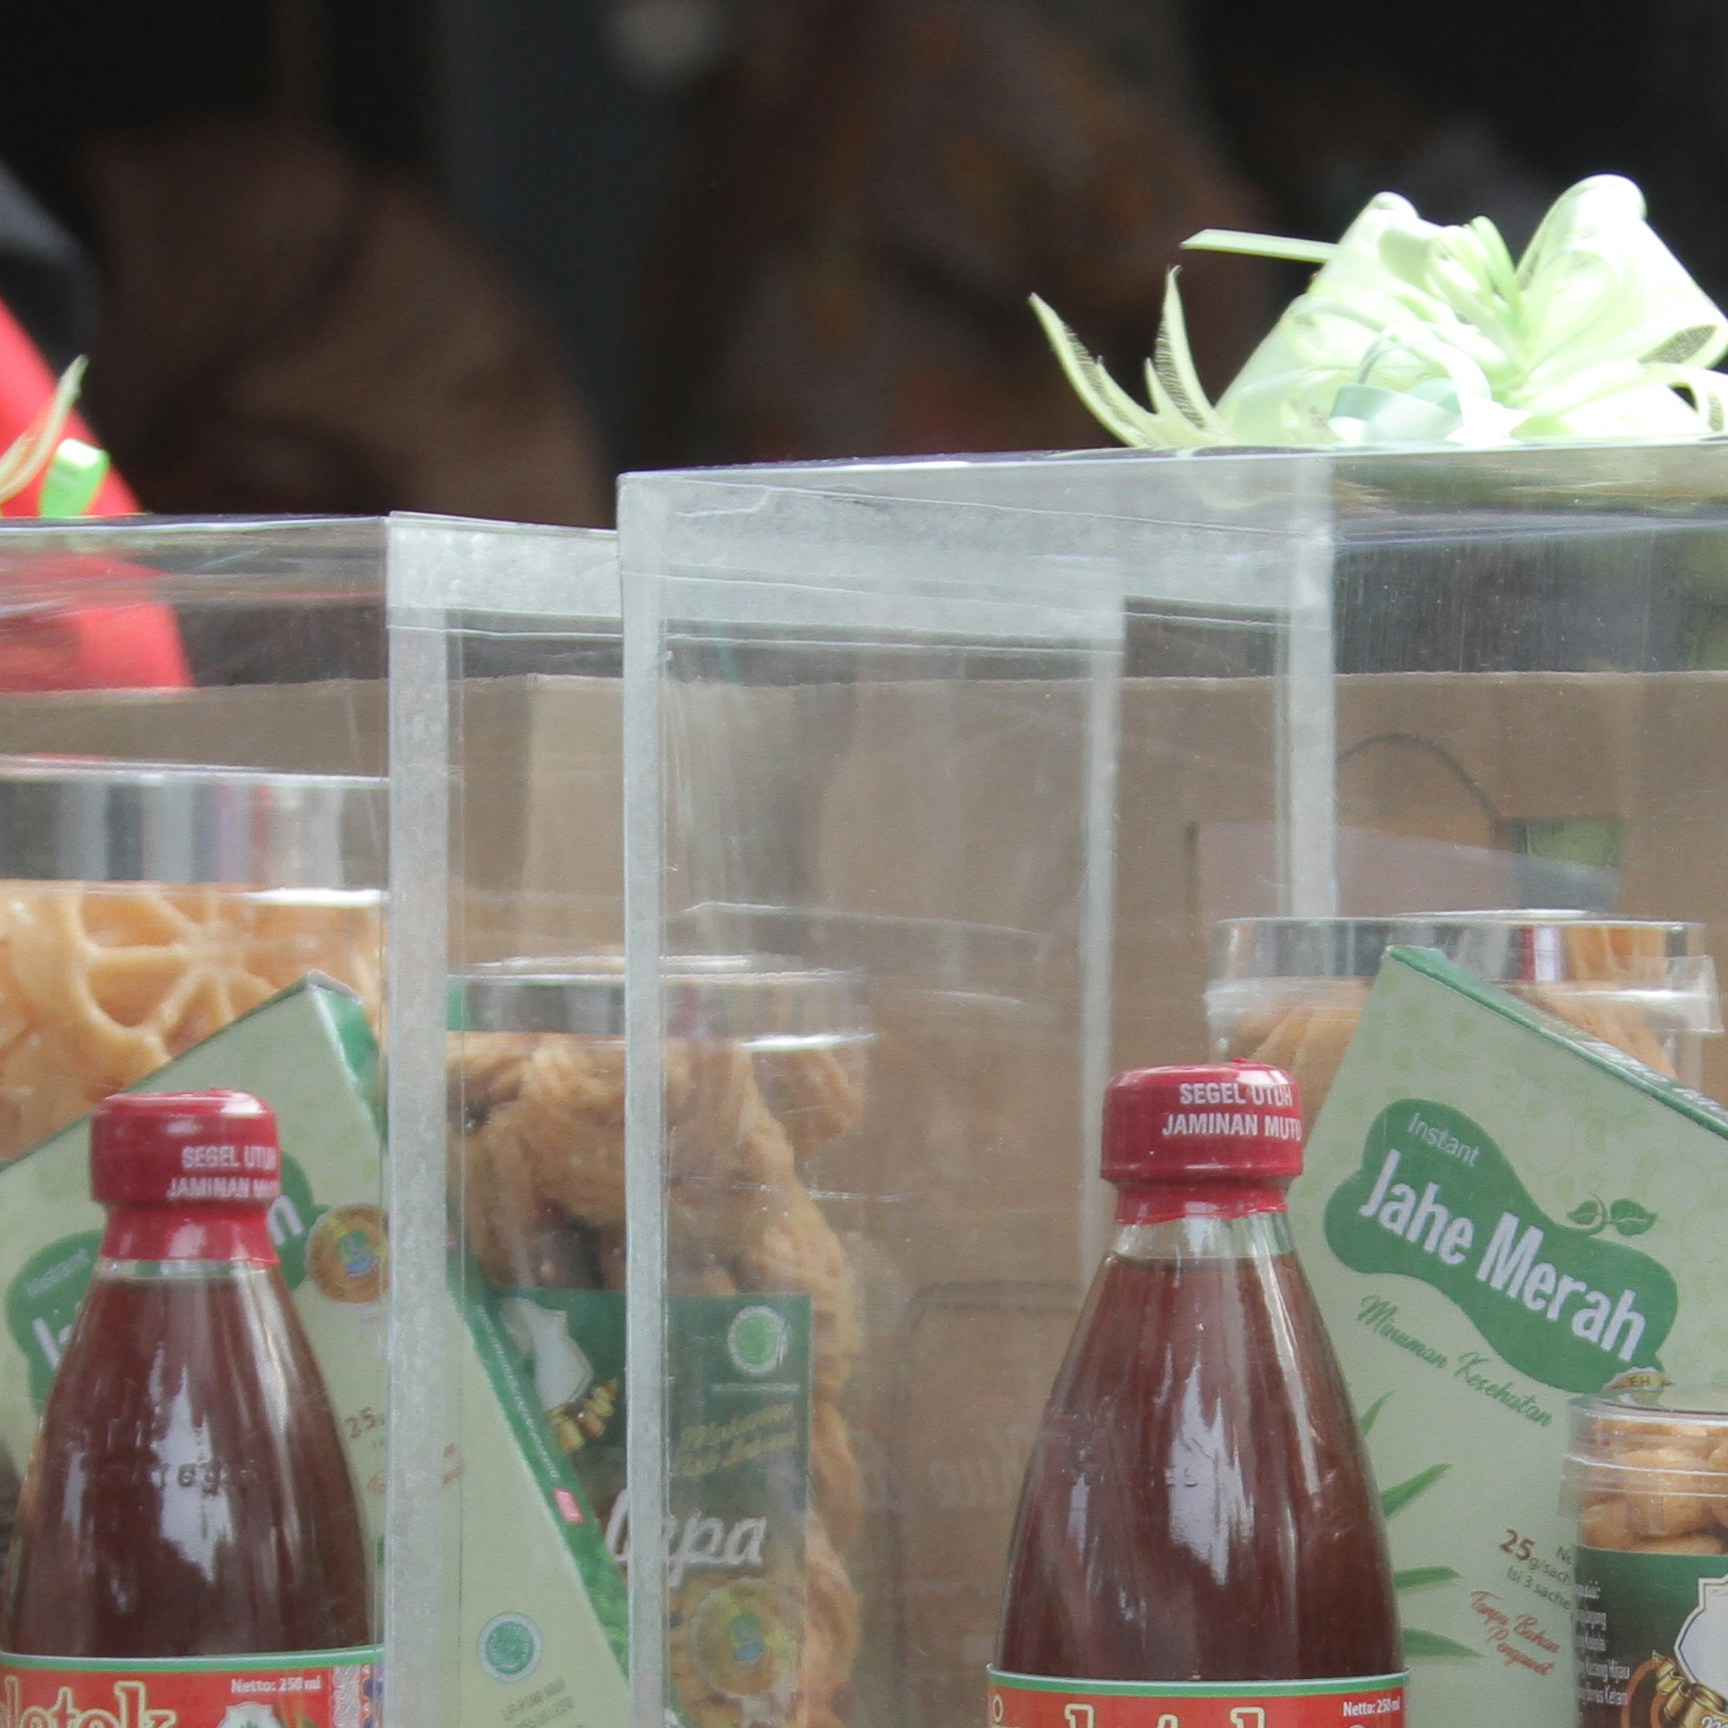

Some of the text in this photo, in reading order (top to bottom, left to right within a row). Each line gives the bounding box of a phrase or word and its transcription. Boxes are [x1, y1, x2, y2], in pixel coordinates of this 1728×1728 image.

[1180, 1082, 1293, 1107] SEGEL UTUH
[1162, 1113, 1258, 1138] JAMINAN
[1407, 1112, 1480, 1167] Instant
[182, 1145, 241, 1169] SEGEL
[165, 1175, 249, 1199] JAMINAN
[1360, 1147, 1646, 1362] Jahe Merah
[1355, 1294, 1554, 1429] Minuman Kesehatan
[1532, 1579, 1572, 1612] sache
[230, 1676, 277, 1695] Netto:
[1343, 1699, 1376, 1718] Netto:
